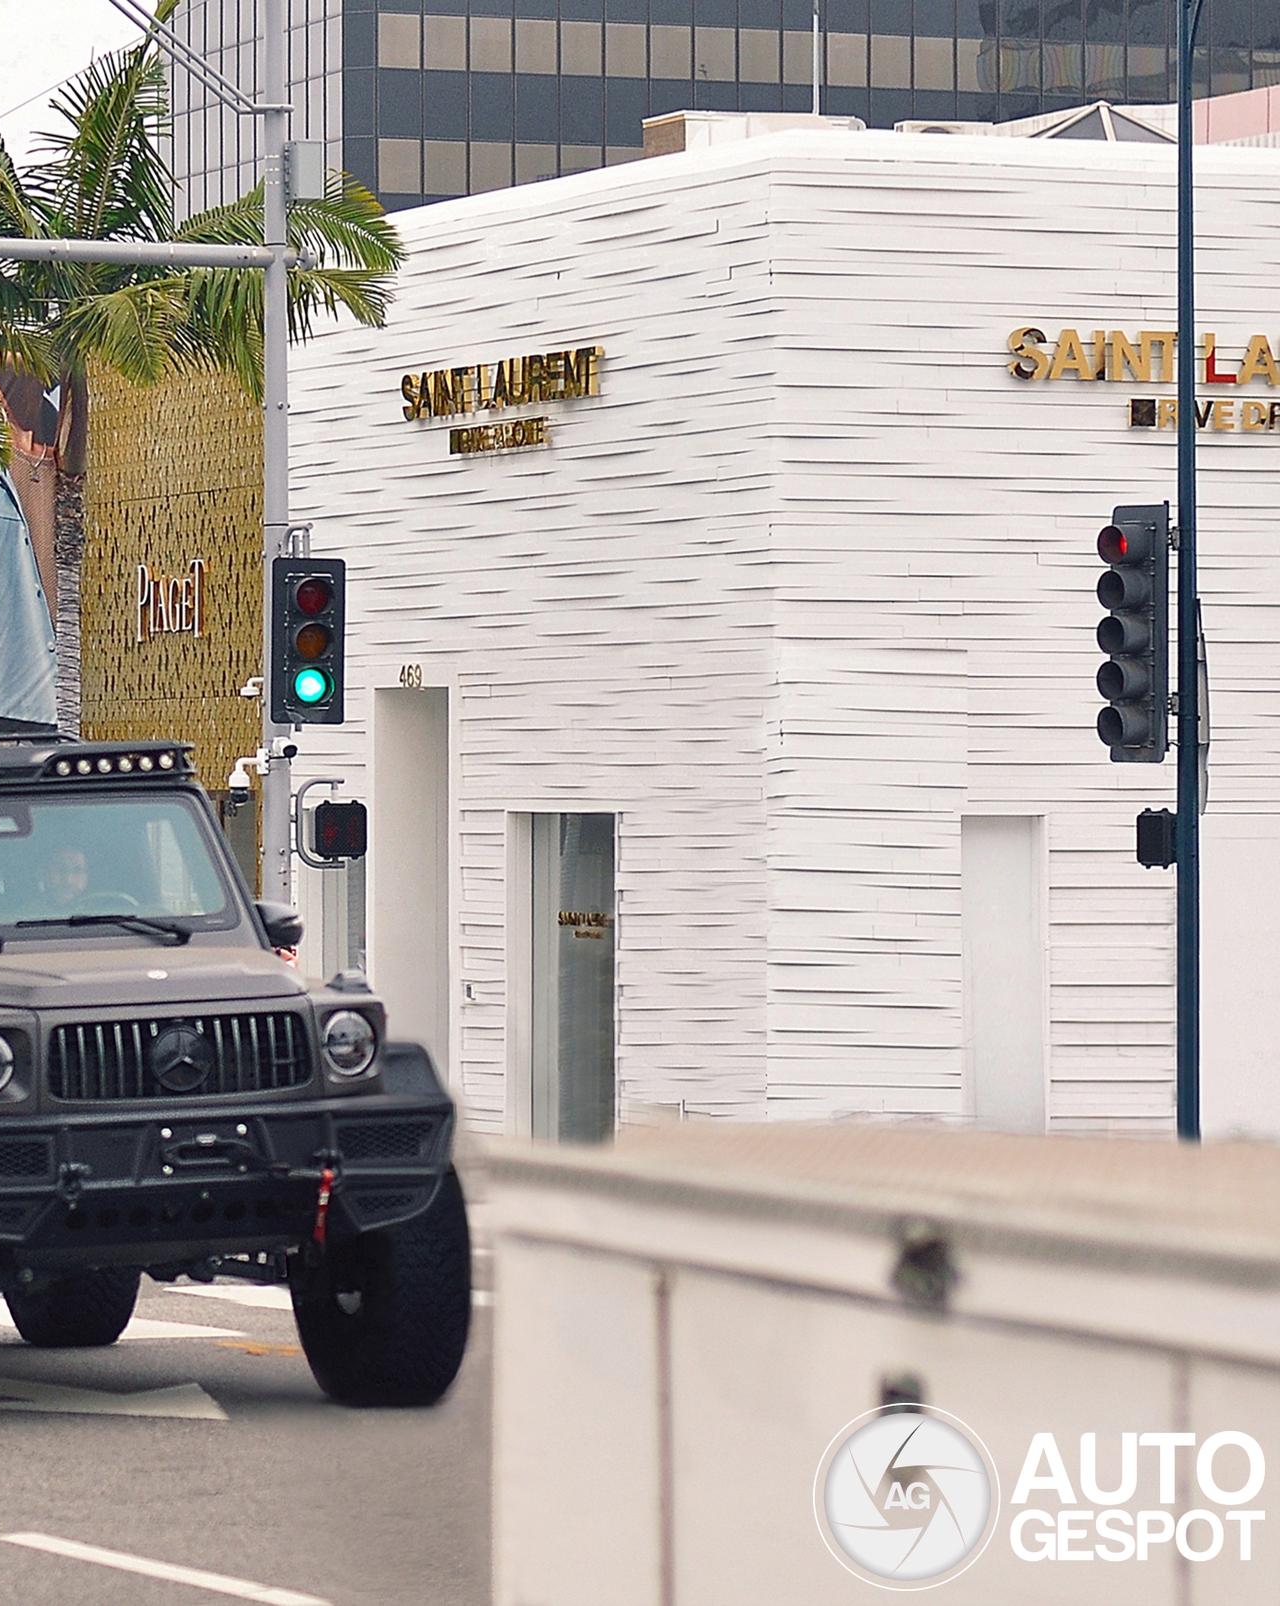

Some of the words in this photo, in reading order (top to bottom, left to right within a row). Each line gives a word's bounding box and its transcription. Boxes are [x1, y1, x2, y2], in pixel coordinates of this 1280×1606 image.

[1007, 327, 1179, 381] SAINT
[401, 366, 475, 422] SAINT
[476, 346, 604, 410] LAURENT
[1158, 399, 1236, 430] RVE
[137, 558, 207, 643] PIAGET
[399, 664, 422, 689] 469
